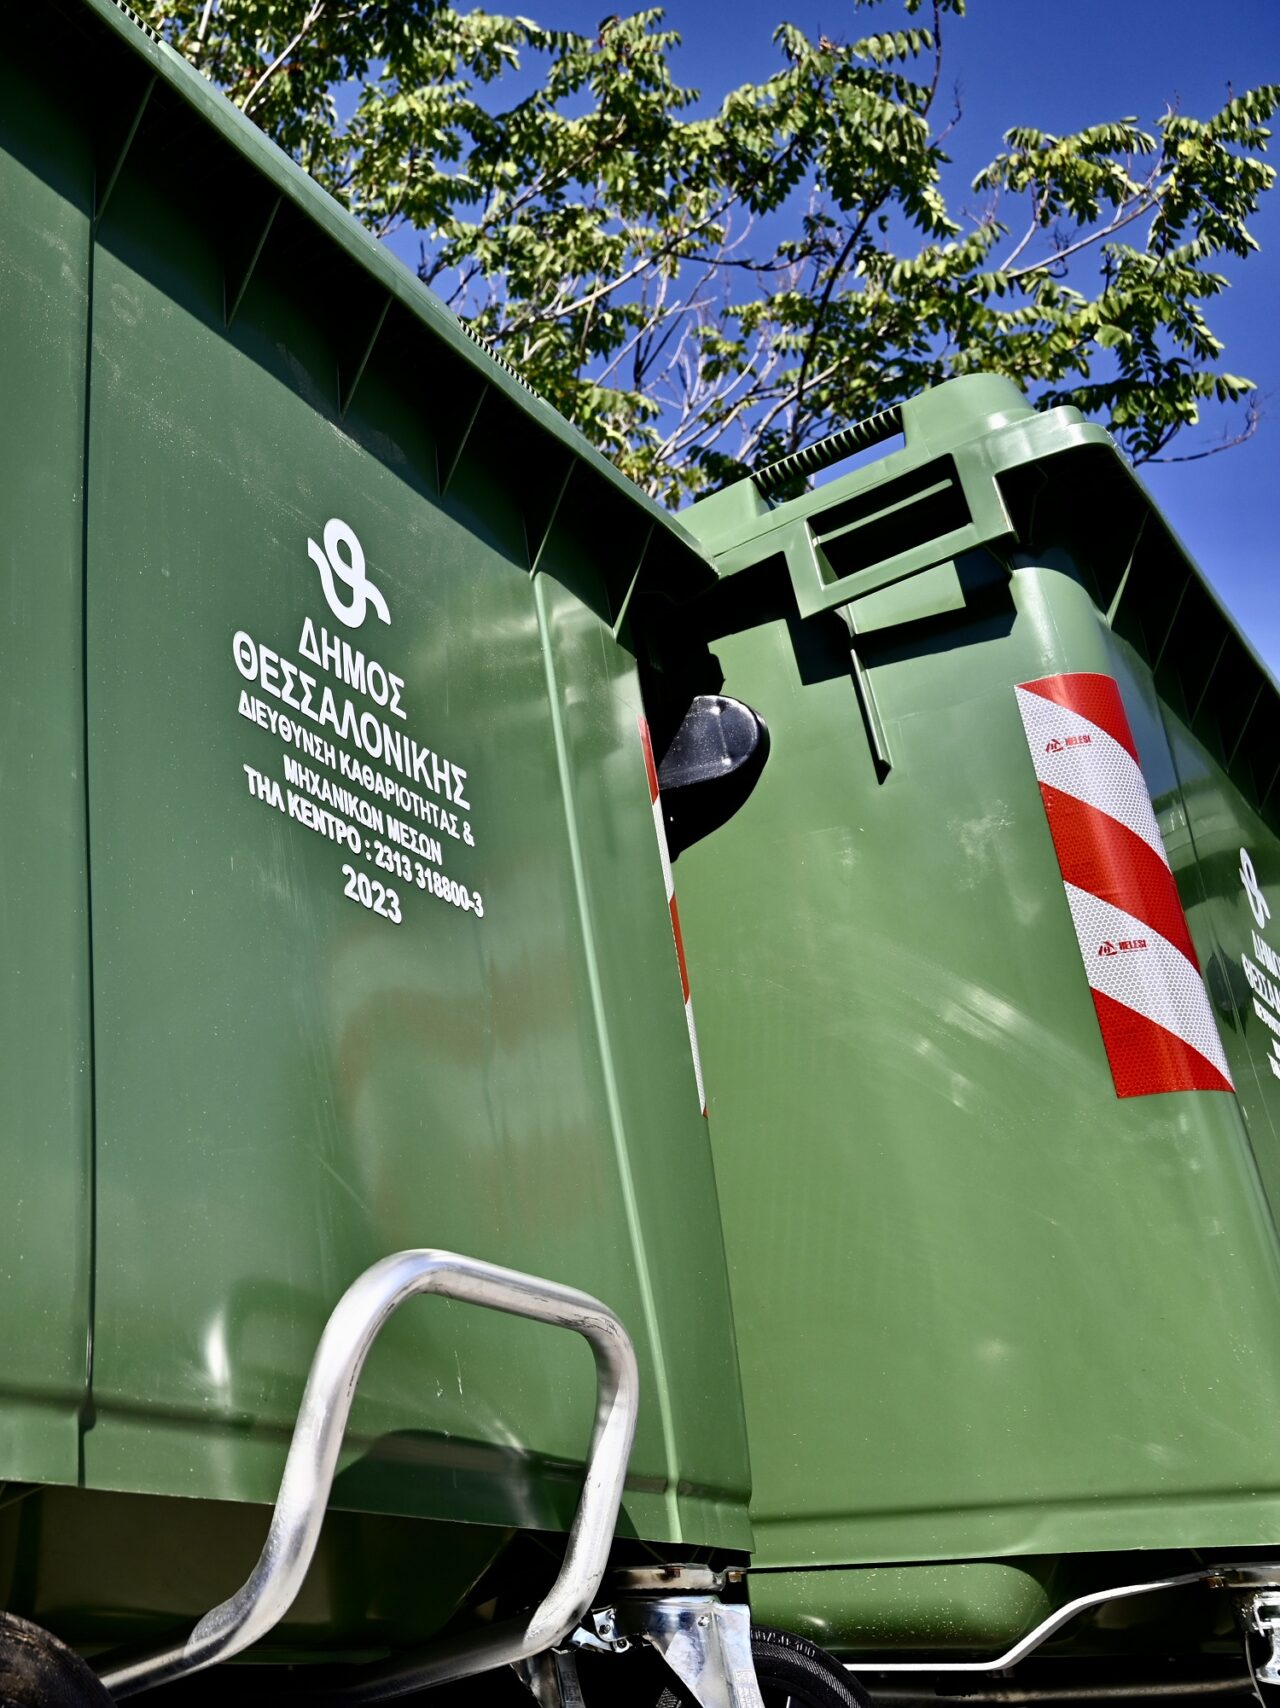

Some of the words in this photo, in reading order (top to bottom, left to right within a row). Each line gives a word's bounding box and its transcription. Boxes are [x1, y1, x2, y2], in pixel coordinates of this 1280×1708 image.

[233, 630, 471, 811] ΘΕΣΣΑΛΟΝΙΚΗΣ
[299, 617, 407, 721] ΔΗΜΟΣ
[238, 690, 337, 770] ΔΙΕΥΘΥΝΣΗ
[339, 749, 461, 840] ΚΑΘΑΡΙΟΤΗΤΑΣ
[462, 820, 476, 847] &
[283, 754, 384, 835] ΜΗΧΑΝΙΚΩΝ
[387, 814, 443, 866] ΜΕΣΩΝ
[243, 764, 286, 813] ΤΗΛ
[287, 789, 362, 856] ΚΕΝΤΡΟ
[373, 839, 413, 883] 2313
[414, 862, 485, 918] 318800-3
[341, 863, 403, 925] 2023
